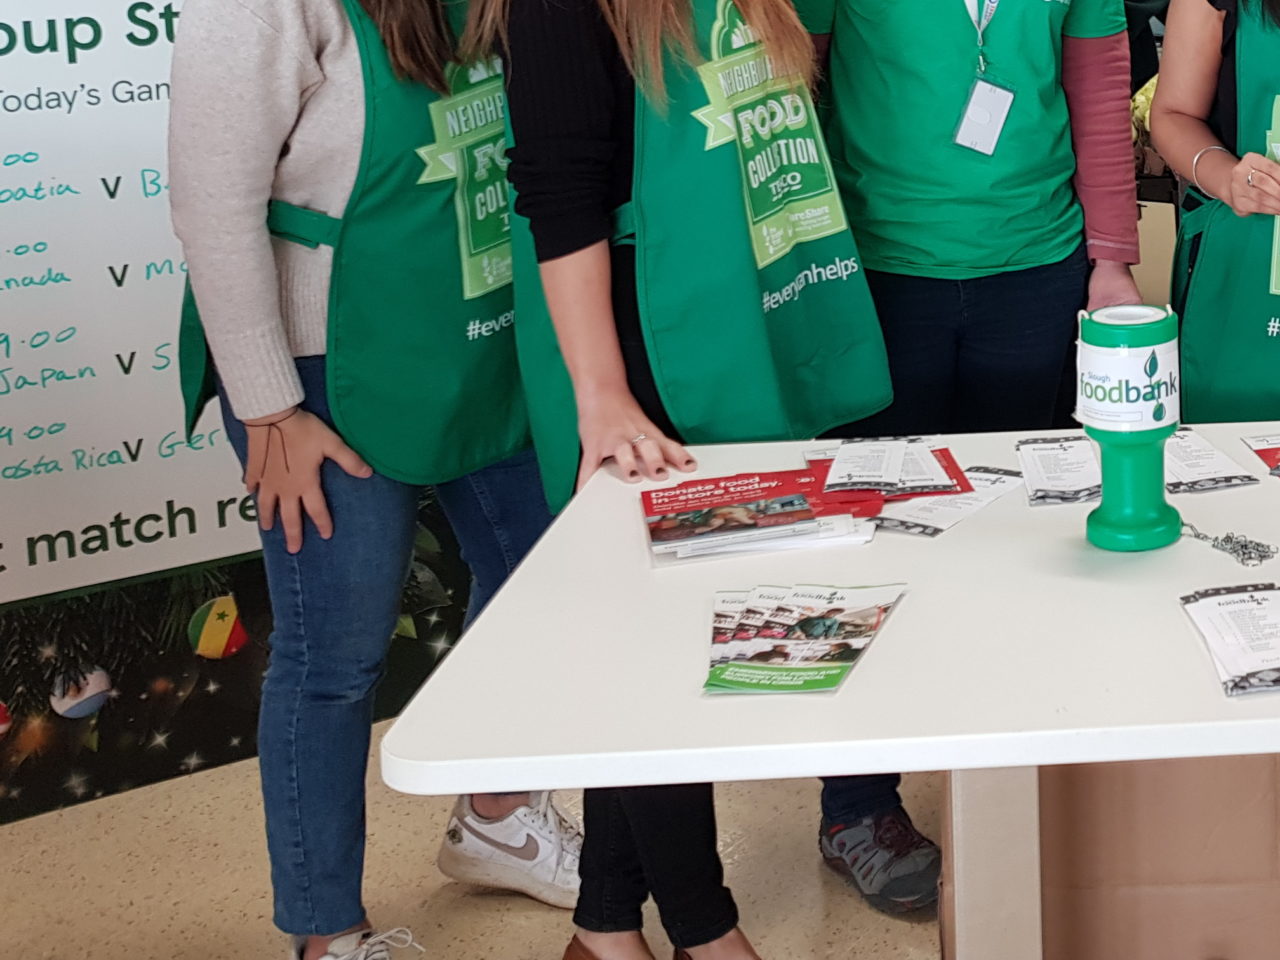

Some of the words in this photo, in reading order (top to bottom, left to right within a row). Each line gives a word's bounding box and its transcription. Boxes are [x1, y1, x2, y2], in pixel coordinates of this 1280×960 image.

[0, 83, 101, 114] oday's
[738, 93, 807, 147] FOOD
[140, 168, 171, 198] B
[0, 267, 72, 291] nada
[1079, 371, 1178, 404] foodbank
[1087, 371, 1111, 383] Slough
[158, 427, 233, 459] Ger
[650, 483, 716, 498] Donate
[719, 476, 760, 488] food
[652, 488, 725, 504] in-store
[728, 480, 783, 493] today.
[26, 499, 197, 566] match
